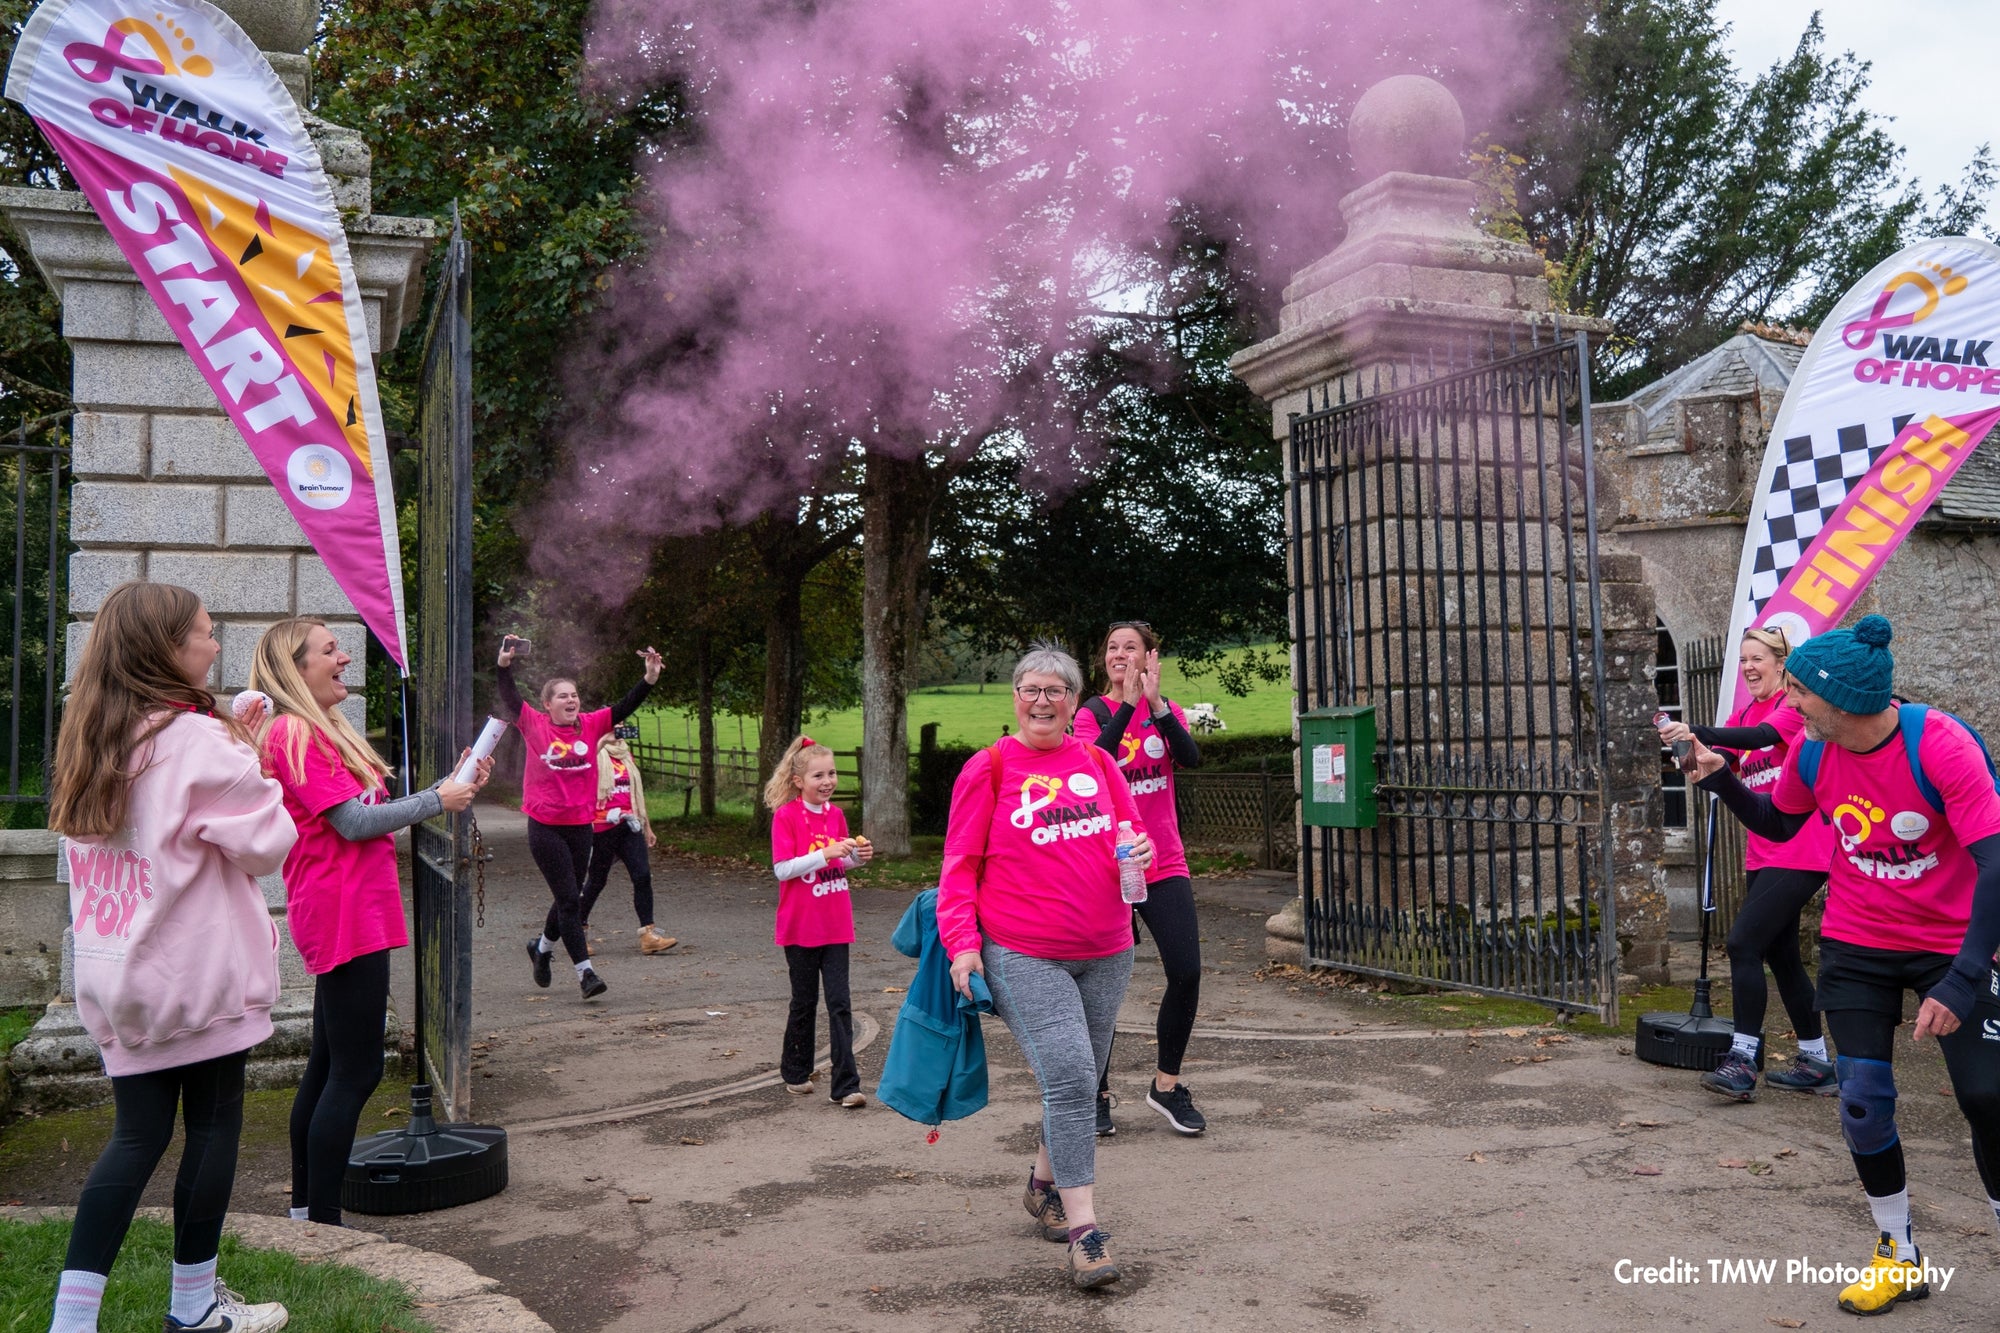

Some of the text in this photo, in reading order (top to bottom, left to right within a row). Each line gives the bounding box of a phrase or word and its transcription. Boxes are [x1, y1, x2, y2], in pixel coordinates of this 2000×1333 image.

[122, 75, 269, 148] WALK
[88, 98, 289, 179] OF HOPE
[105, 181, 318, 434] START
[1883, 333, 1993, 366] WALK
[1854, 358, 2000, 395] OF HOPE
[1789, 413, 1971, 618] FINISH
[1741, 756, 1773, 777] WALK
[1130, 776, 1167, 796] HOPE
[1031, 814, 1112, 845] OF HOPE
[1038, 801, 1103, 826] WALK
[1856, 843, 1925, 865] WALK
[1876, 851, 1939, 880] HOPE
[70, 846, 153, 900] WHITE
[812, 881, 831, 897] OF
[73, 884, 140, 940] FOX
